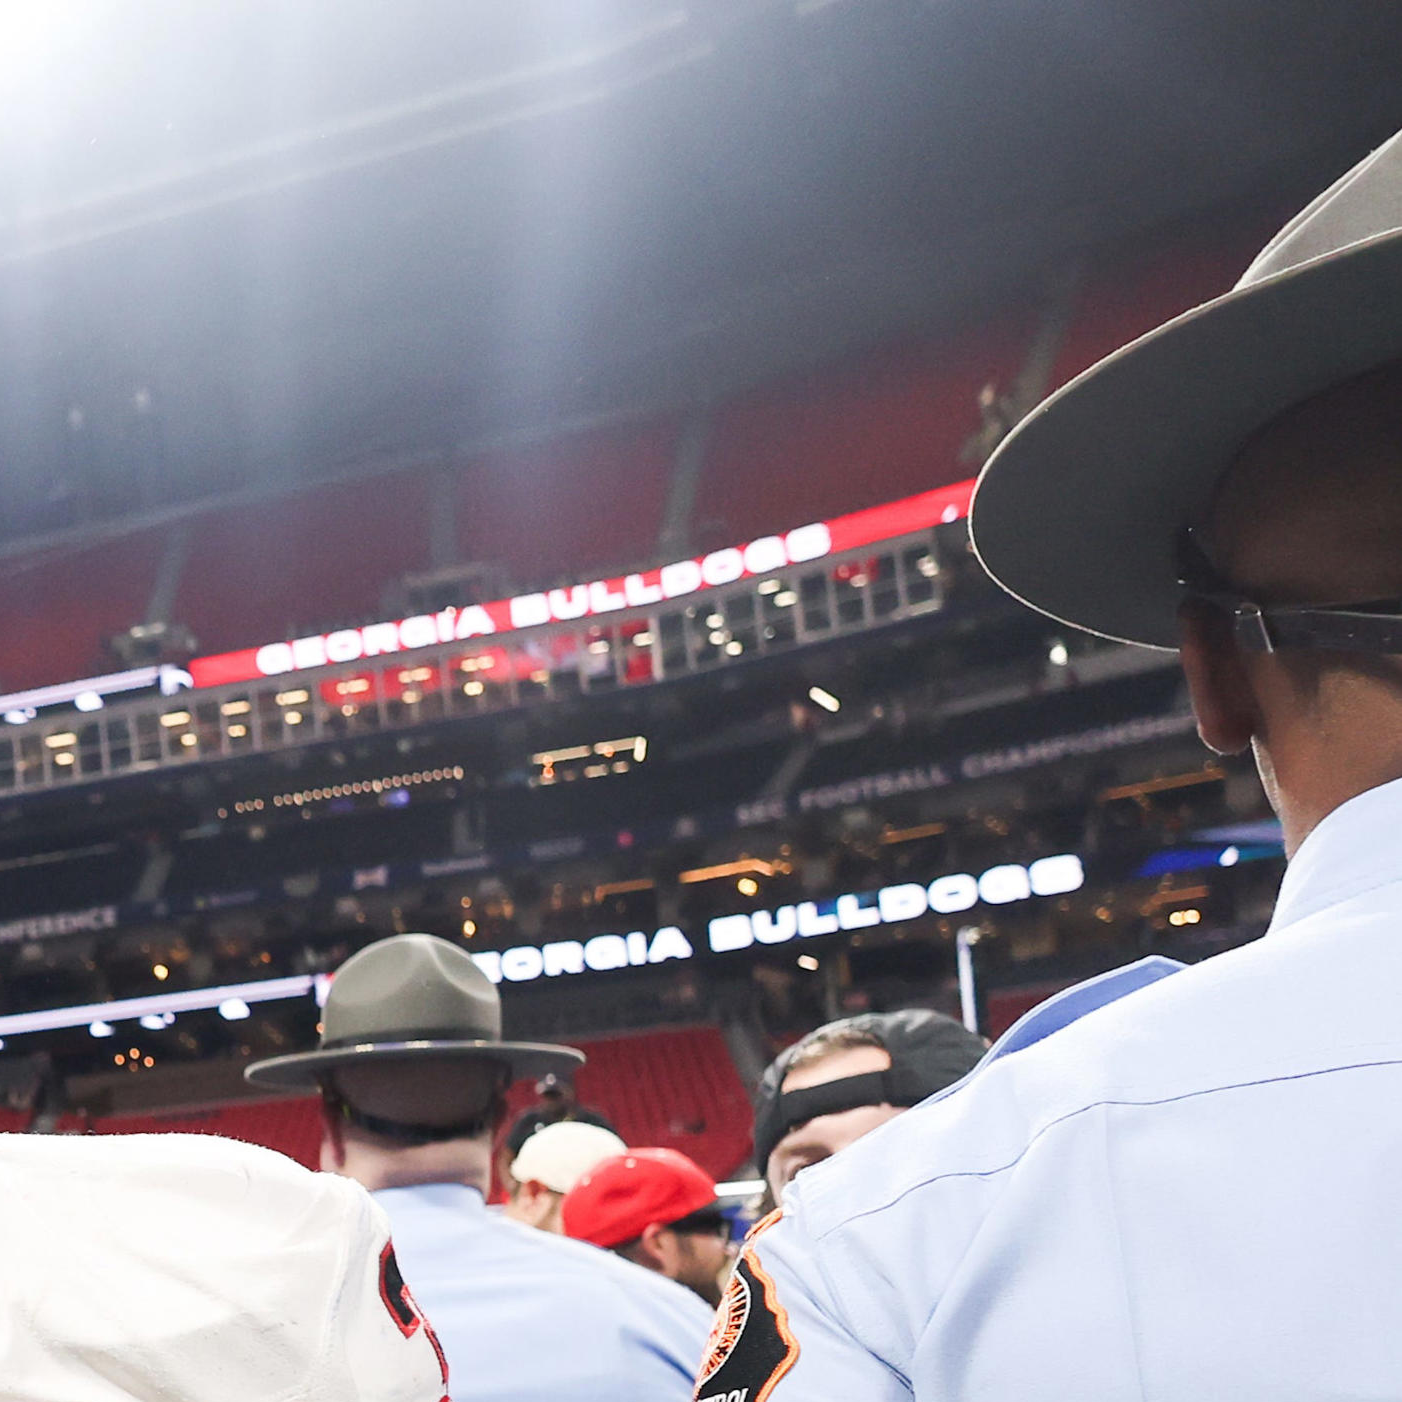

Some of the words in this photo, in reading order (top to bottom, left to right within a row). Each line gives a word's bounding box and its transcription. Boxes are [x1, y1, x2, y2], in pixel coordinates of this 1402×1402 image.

[255, 605, 495, 675] GEORGIA
[510, 522, 832, 629] BULLDOGS
[708, 853, 1085, 954] BULLDOGS
